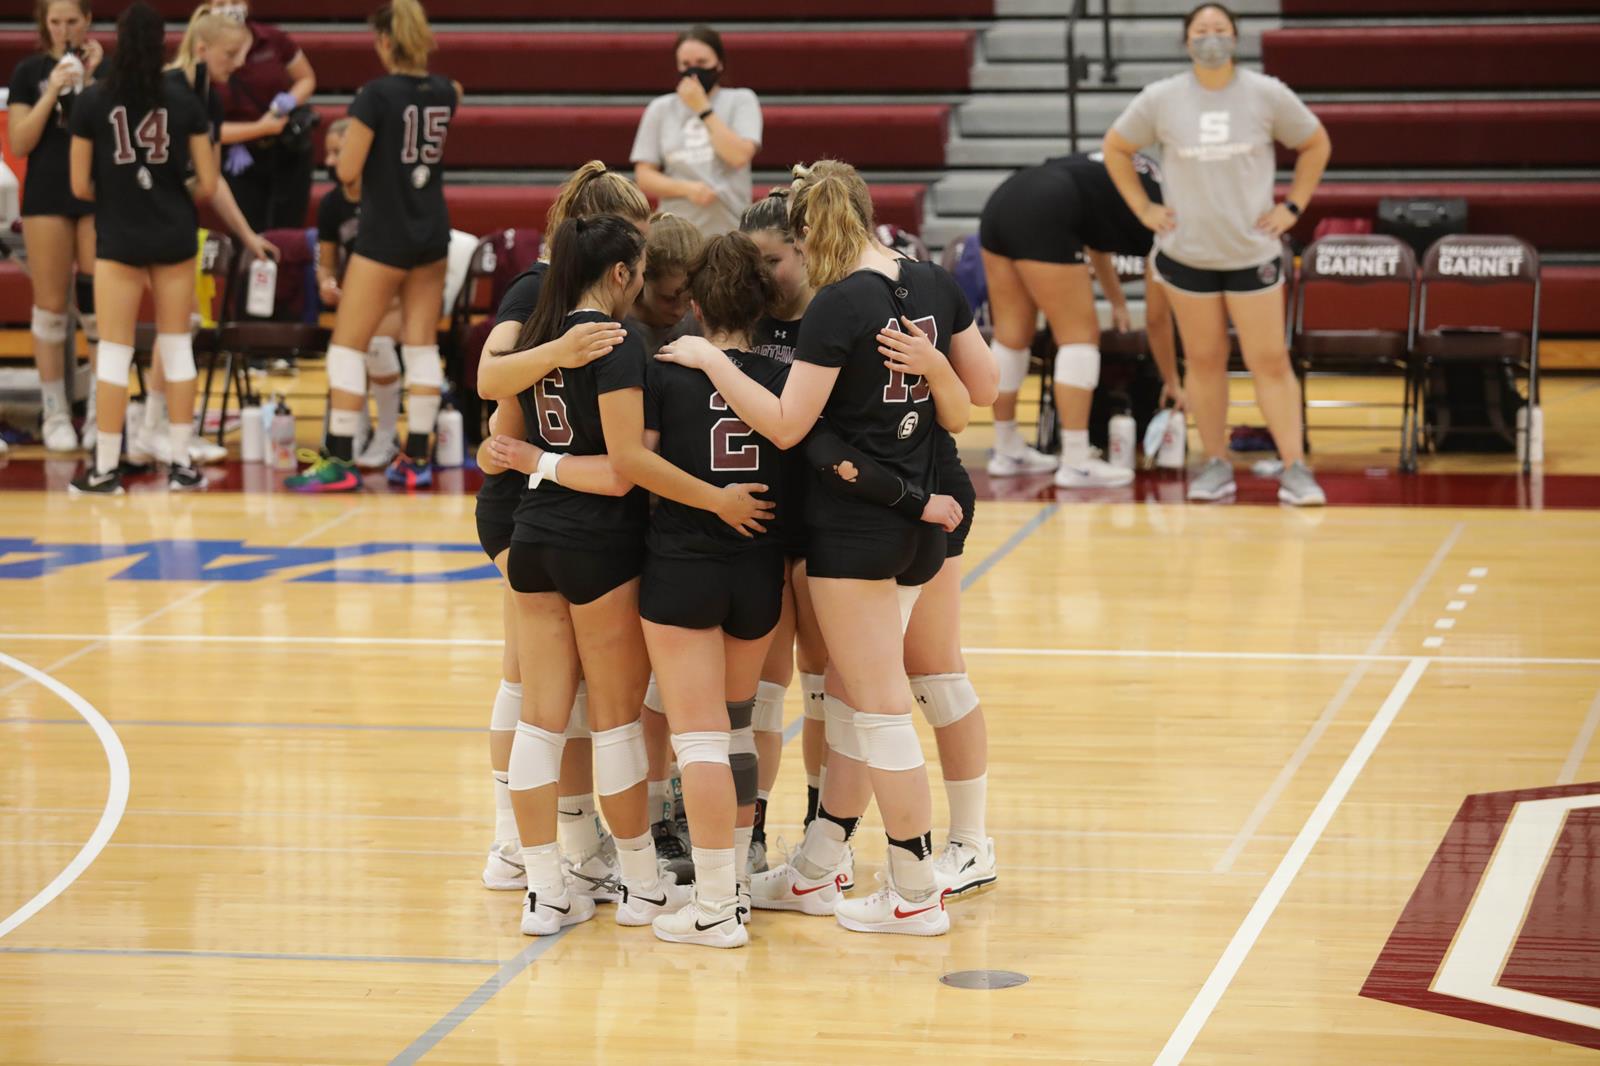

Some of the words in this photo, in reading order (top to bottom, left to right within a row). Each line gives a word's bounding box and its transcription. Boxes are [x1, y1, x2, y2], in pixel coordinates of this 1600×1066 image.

[108, 105, 170, 165] 14
[401, 104, 451, 164] 15
[1316, 254, 1400, 276] GARNET
[1438, 254, 1524, 276] GARNET
[533, 367, 574, 446] 6
